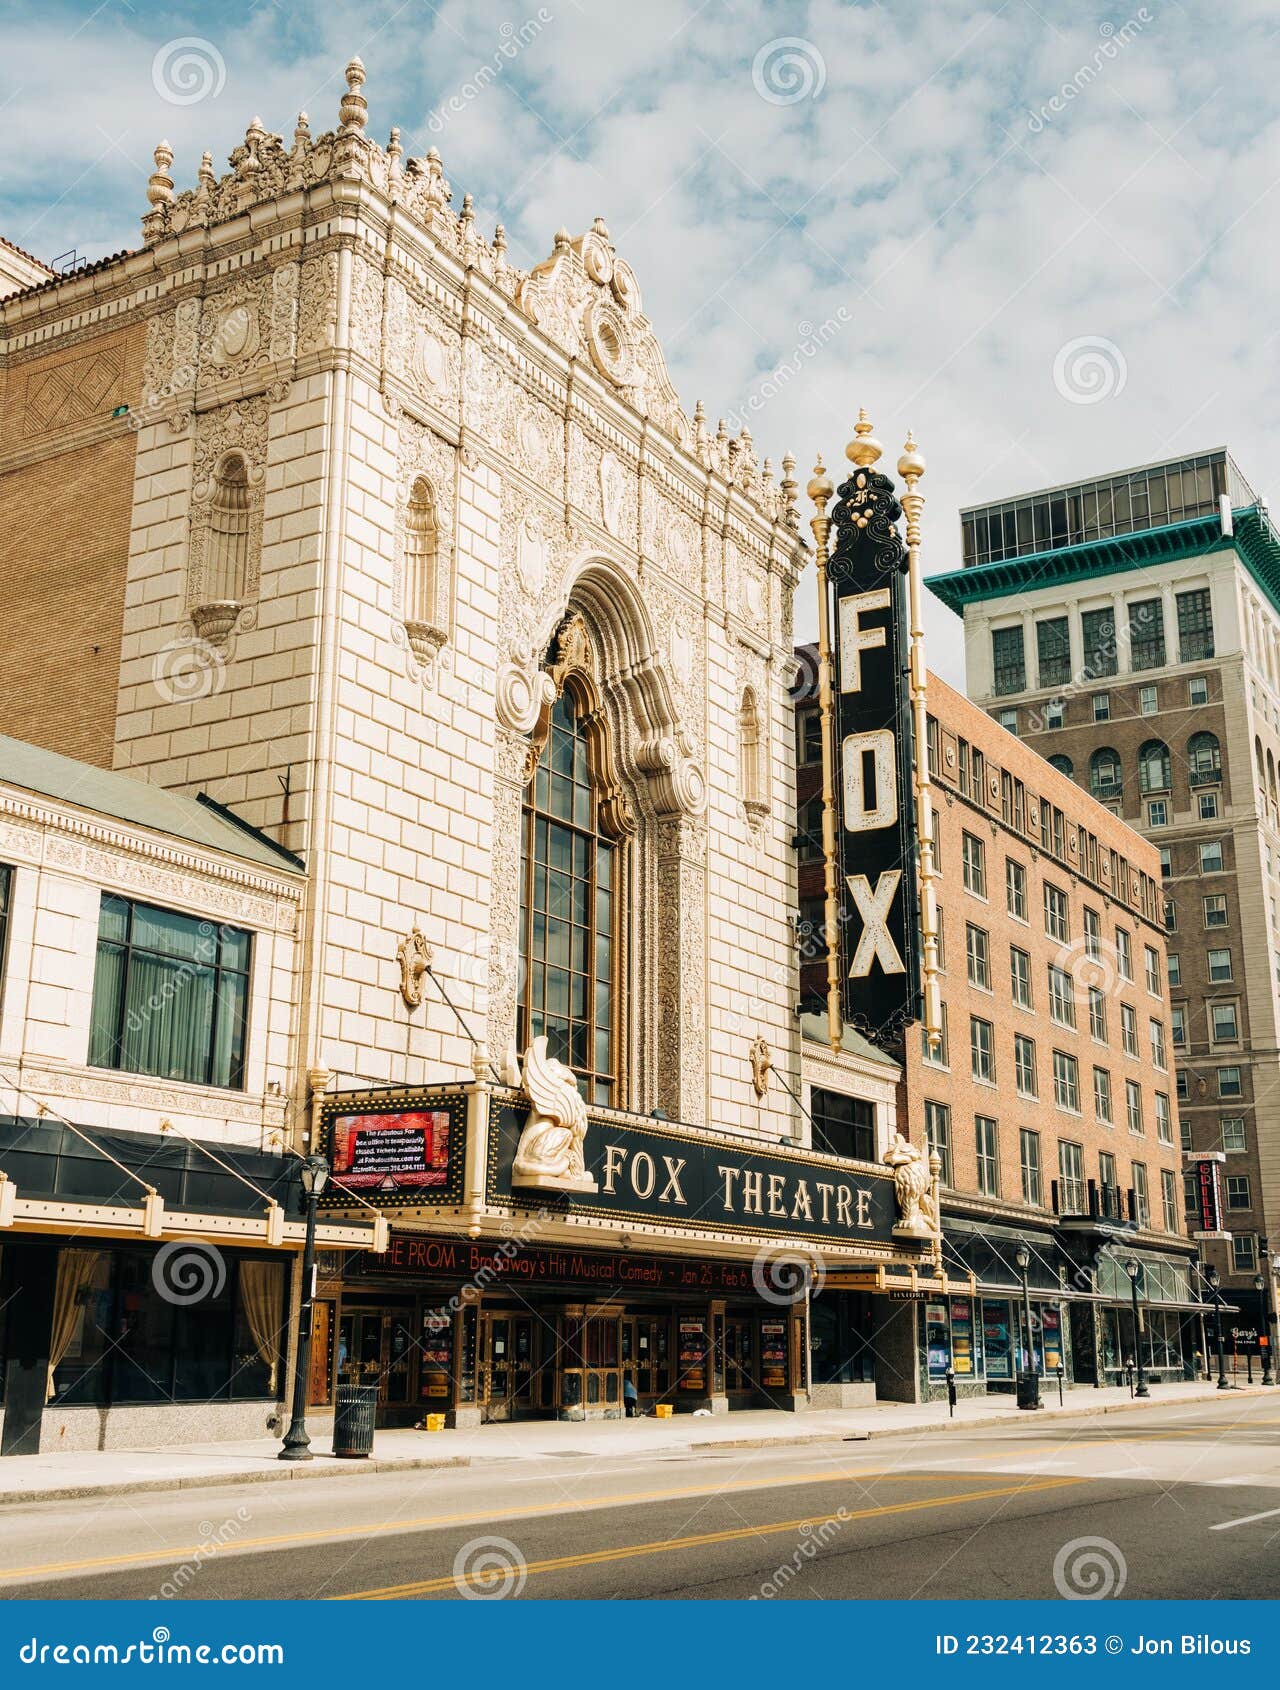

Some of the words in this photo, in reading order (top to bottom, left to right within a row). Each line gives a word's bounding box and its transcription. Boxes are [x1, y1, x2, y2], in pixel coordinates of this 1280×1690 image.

[838, 588, 906, 979] FOX
[602, 1145, 688, 1206] FOX
[717, 1165, 875, 1230] THEATRE
[1200, 1163, 1216, 1230] GRILLE
[408, 1242, 456, 1269] PROM
[469, 1247, 546, 1278] Broadway's
[549, 1252, 567, 1276] Hit
[570, 1256, 616, 1279] Musical
[618, 1258, 664, 1286] Comedy
[680, 1263, 698, 1283] Jan
[721, 1266, 738, 1287] Feb
